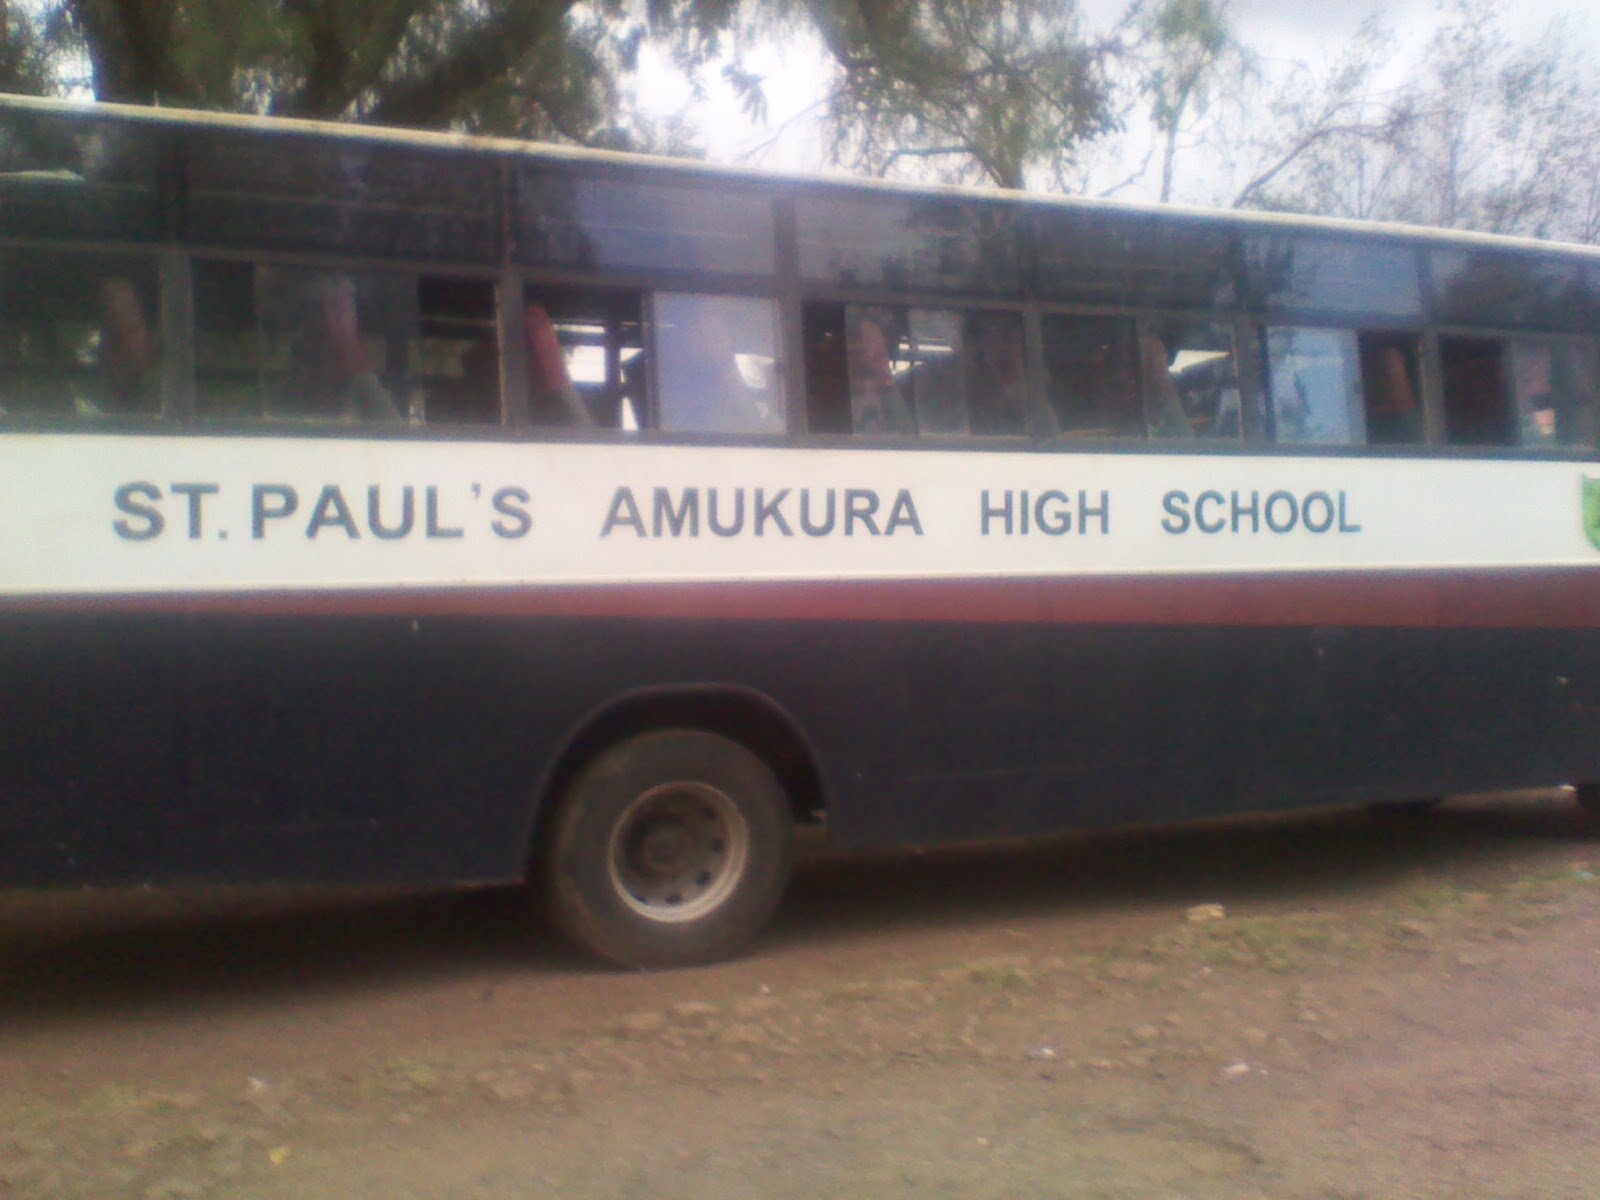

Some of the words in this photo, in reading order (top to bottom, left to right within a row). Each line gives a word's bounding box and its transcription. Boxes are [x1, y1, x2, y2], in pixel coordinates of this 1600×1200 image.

[112, 481, 229, 540] ST.
[251, 482, 534, 538] PAUL'S
[600, 487, 922, 538] AMUKURA
[980, 490, 1110, 536] HIGH
[1161, 490, 1361, 534] SCHOOL
